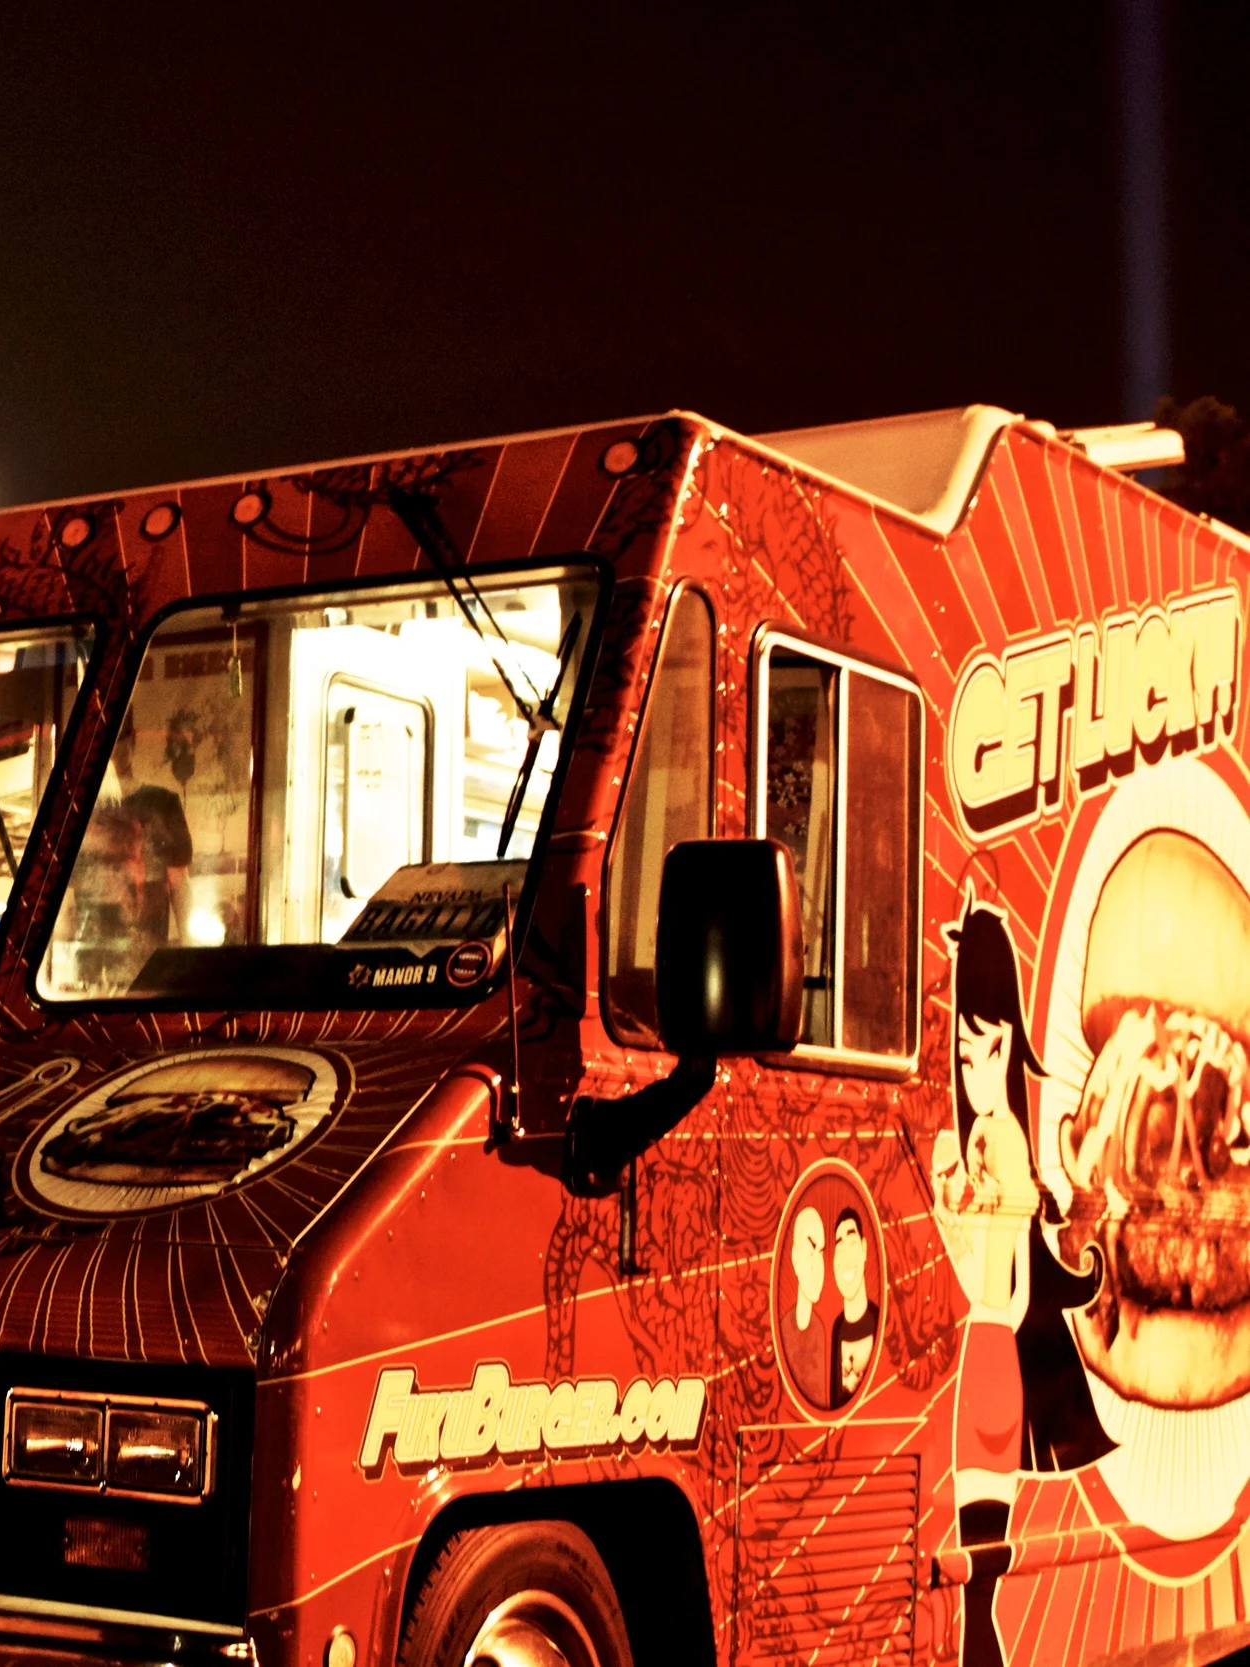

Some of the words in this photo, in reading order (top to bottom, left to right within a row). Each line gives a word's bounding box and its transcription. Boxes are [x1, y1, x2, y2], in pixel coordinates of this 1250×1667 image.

[953, 636, 1075, 828] GET
[409, 890, 484, 905] NEVADA
[372, 966, 422, 987] MANOR
[426, 965, 438, 983] 9
